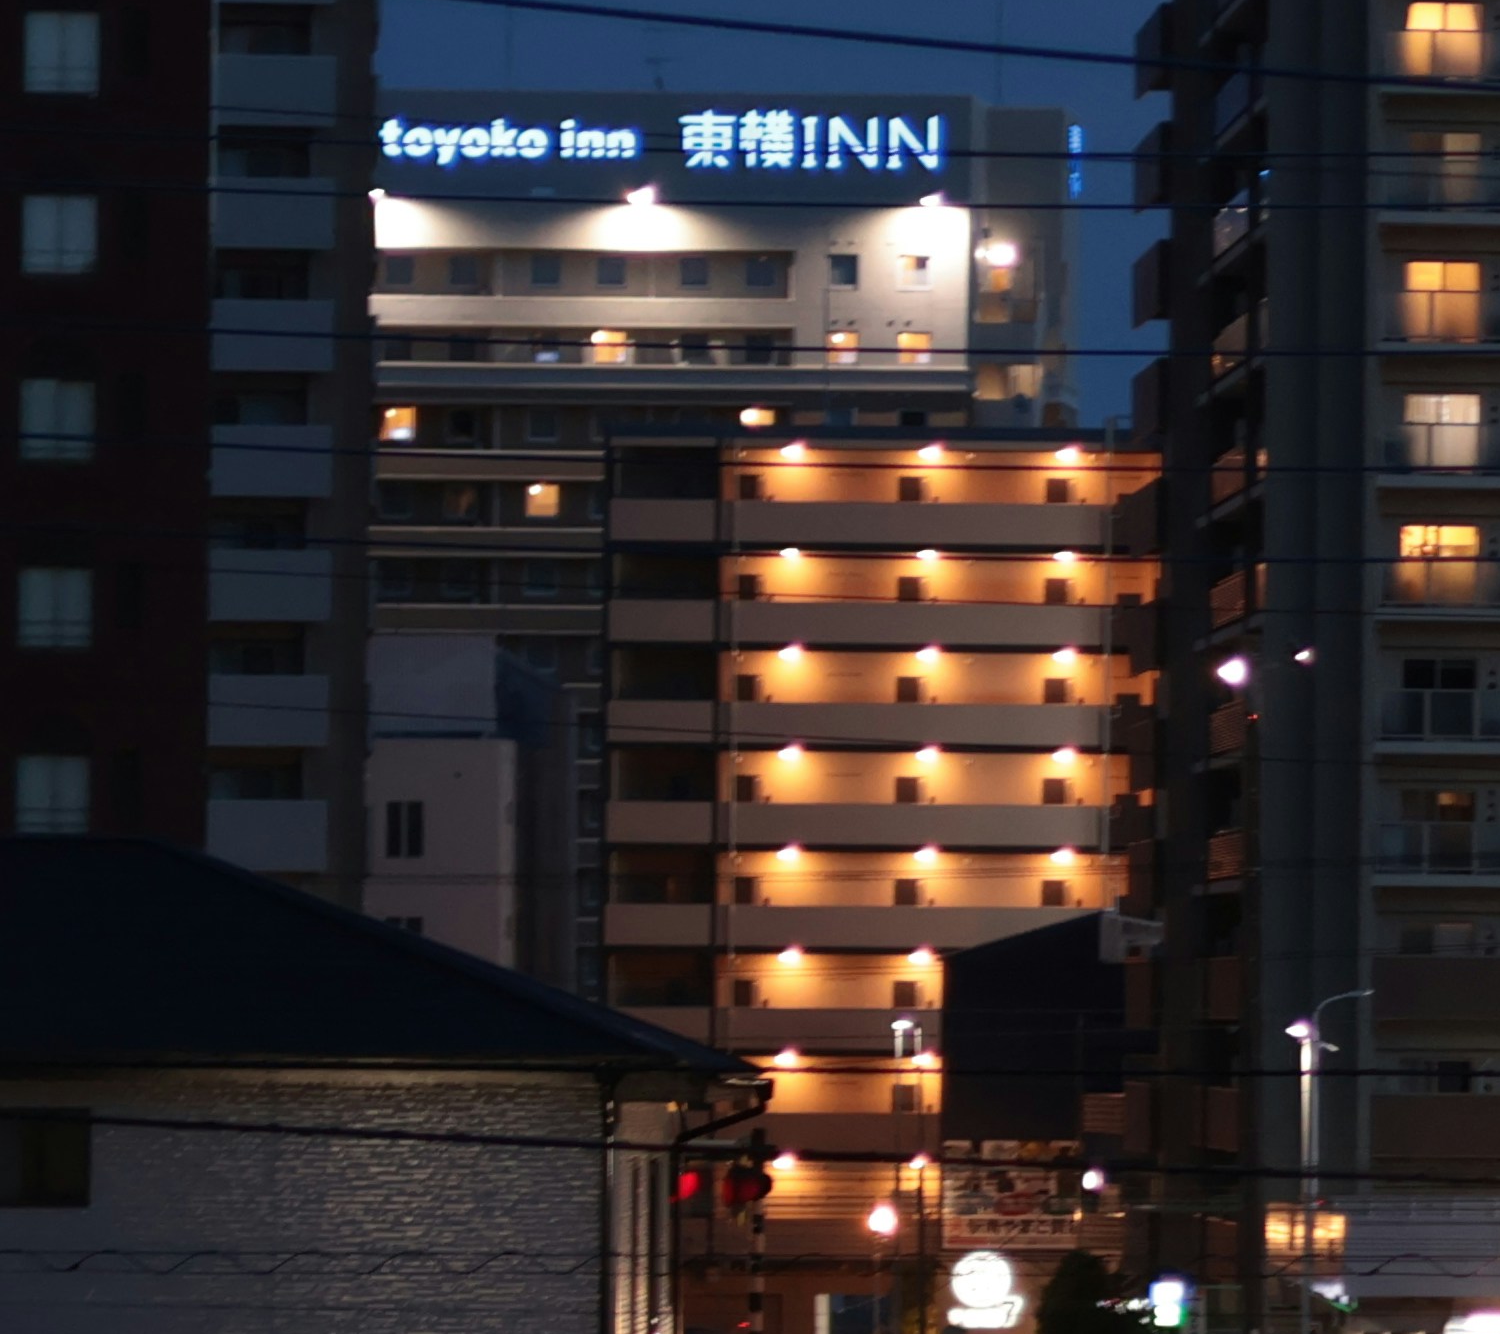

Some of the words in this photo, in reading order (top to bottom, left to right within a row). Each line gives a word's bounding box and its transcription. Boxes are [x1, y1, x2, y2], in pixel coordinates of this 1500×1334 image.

[378, 117, 548, 166] toyoko
[559, 118, 636, 159] inn
[677, 108, 943, 171] 東横INN
